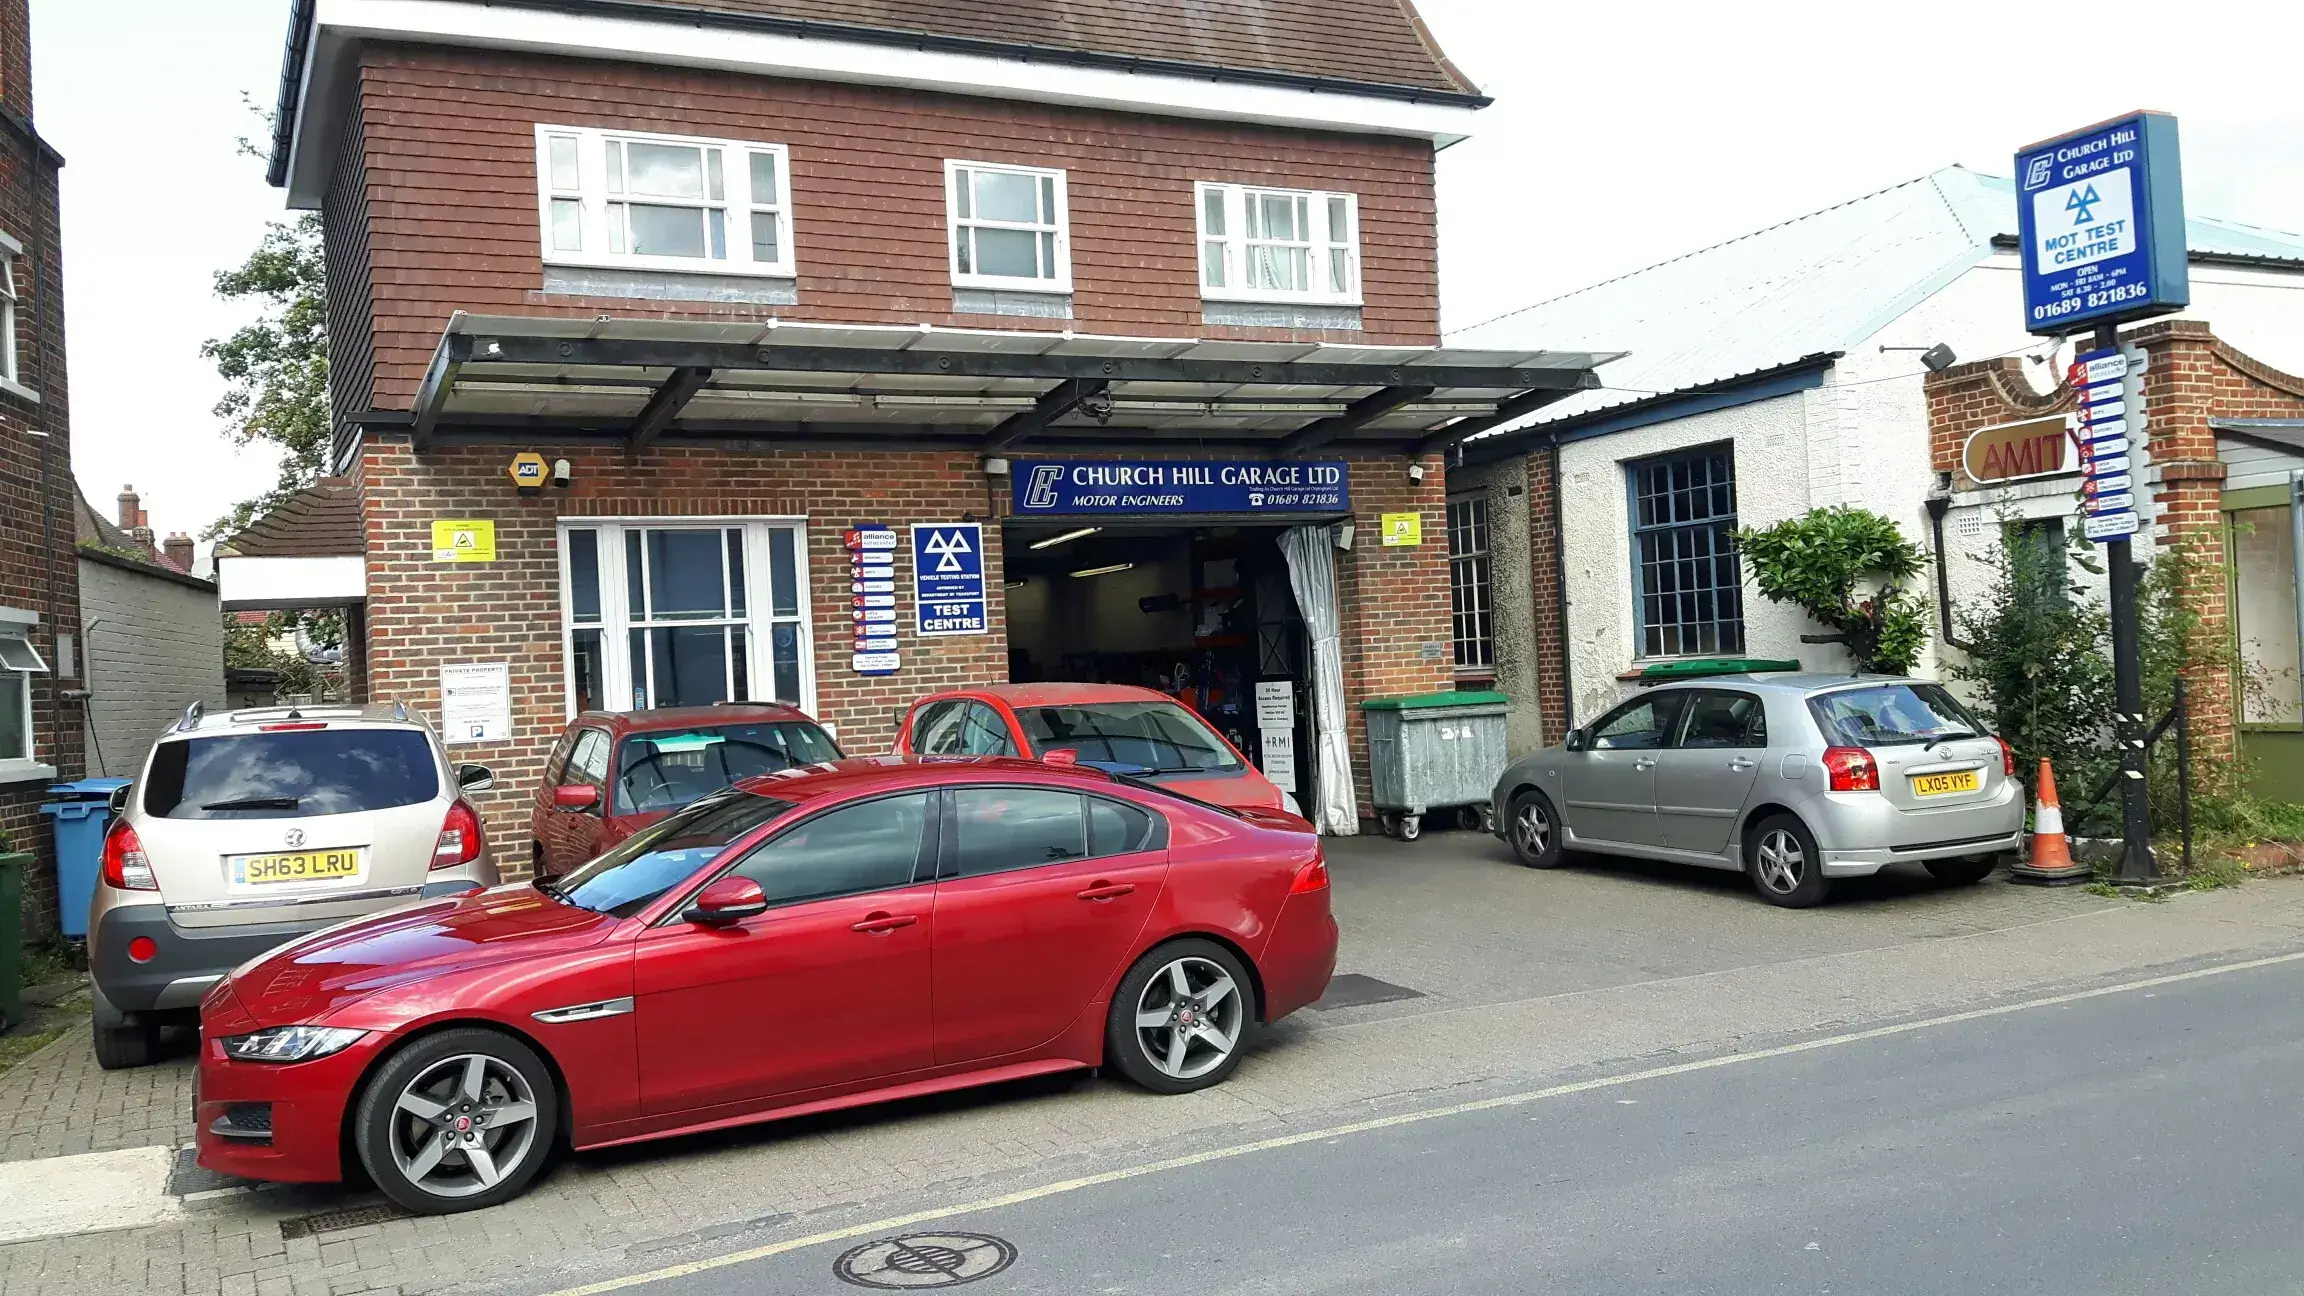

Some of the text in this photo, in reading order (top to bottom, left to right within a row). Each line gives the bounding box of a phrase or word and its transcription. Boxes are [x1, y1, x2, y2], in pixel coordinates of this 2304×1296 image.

[2057, 130, 2136, 162] CHURCH HILL
[2063, 150, 2134, 179] GARAGE LTD
[2045, 220, 2126, 251] MOT TEST
[2055, 238, 2119, 264] CENTRE
[2077, 265, 2098, 276] OPEN
[2050, 282, 2069, 293] MON
[2075, 278, 2086, 287] FRI
[2111, 267, 2127, 277] 6PM
[2034, 281, 2147, 320] 01689 821836
[2061, 289, 2074, 298] SAT
[2089, 359, 2124, 372] alliance
[518, 465, 539, 474] ADT
[1072, 466, 1340, 486] CHURCH HILL GARAGE LTD
[1072, 494, 1184, 506] MOTOR ENGINEERS
[1267, 493, 1339, 505] 01689 821836
[933, 604, 970, 616] TEST
[924, 617, 981, 630] CENTRE
[1271, 736, 1290, 748] RMI
[1918, 774, 1972, 793] LX05 VYF
[249, 853, 354, 878] SH63 LRU
